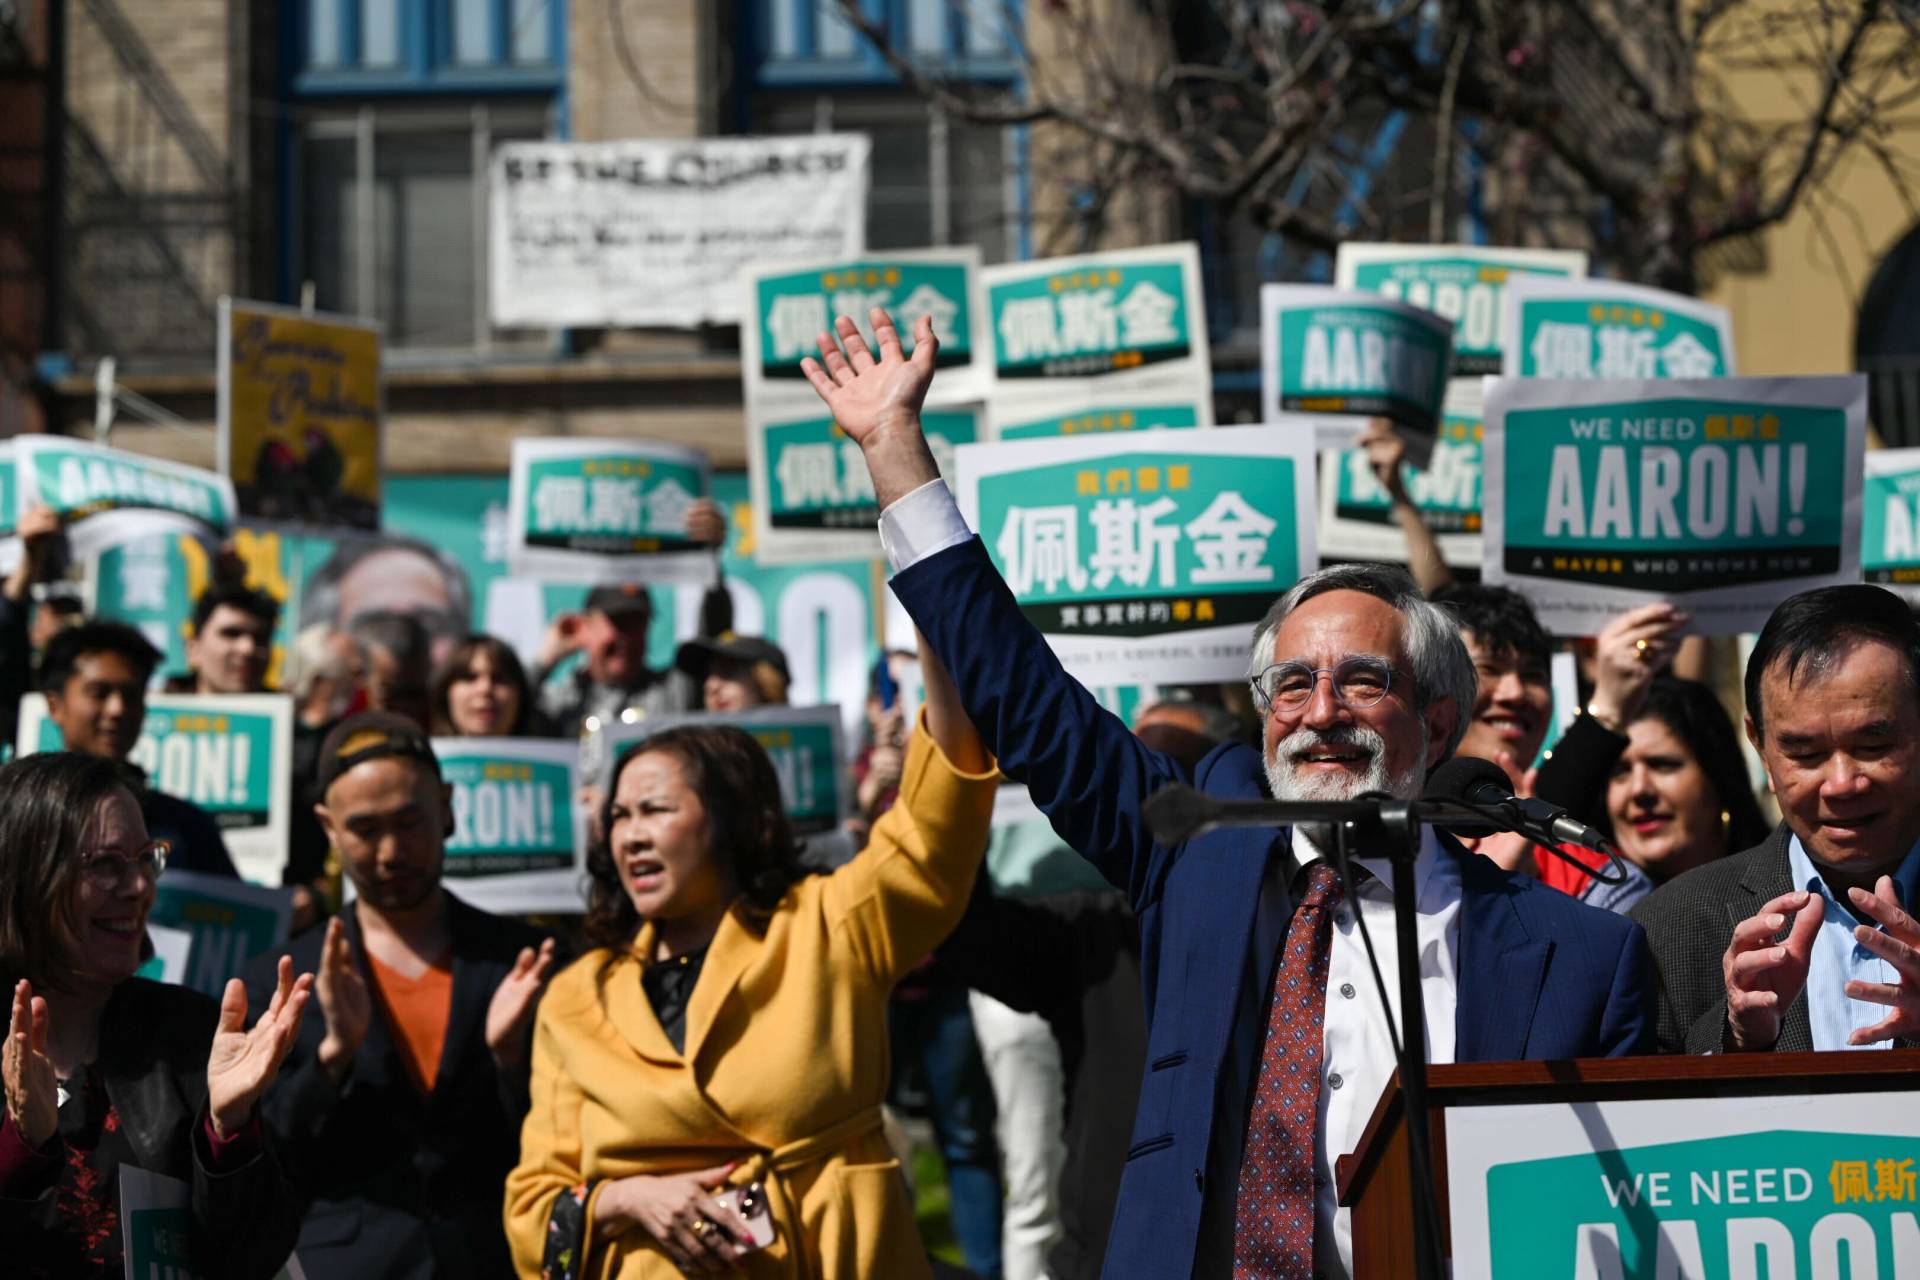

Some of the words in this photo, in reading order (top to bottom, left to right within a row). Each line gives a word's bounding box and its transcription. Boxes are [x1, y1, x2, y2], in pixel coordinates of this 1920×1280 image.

[1570, 418, 1613, 440] WE
[1621, 417, 1696, 440] NEED
[1542, 443, 1807, 540] AARON!
[997, 491, 1278, 596] 佩斯金
[1552, 558, 1623, 573] MAYOR
[1633, 558, 1680, 574] WHO
[446, 781, 554, 849] RON!
[1601, 1171, 1673, 1208] WE
[1690, 1167, 1813, 1205] NEED
